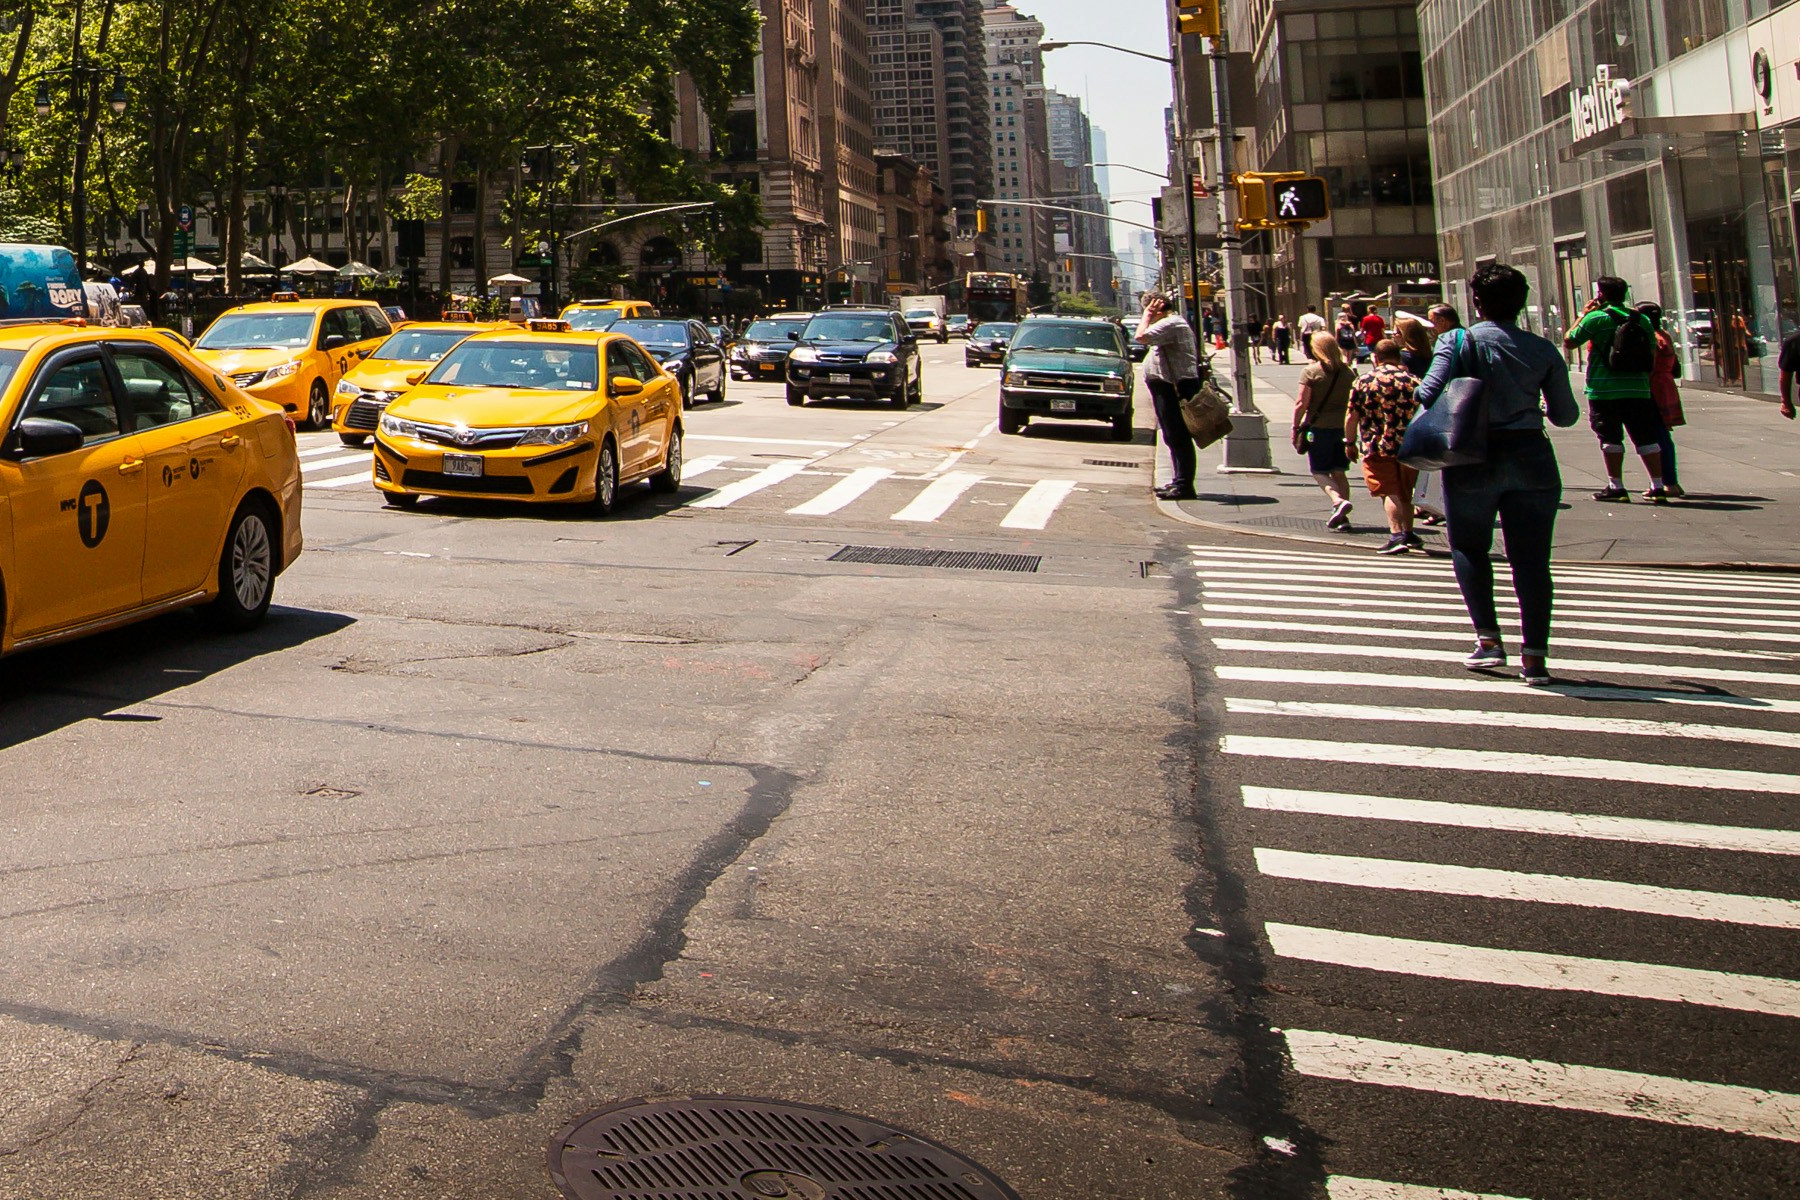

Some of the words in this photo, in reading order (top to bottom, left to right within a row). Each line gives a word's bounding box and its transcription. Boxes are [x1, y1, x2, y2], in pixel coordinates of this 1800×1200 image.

[1569, 64, 1628, 143] MetLife
[1386, 262, 1393, 275] A
[49, 288, 81, 304] DORY
[537, 321, 558, 330] 9A85
[60, 498, 77, 512] NYC
